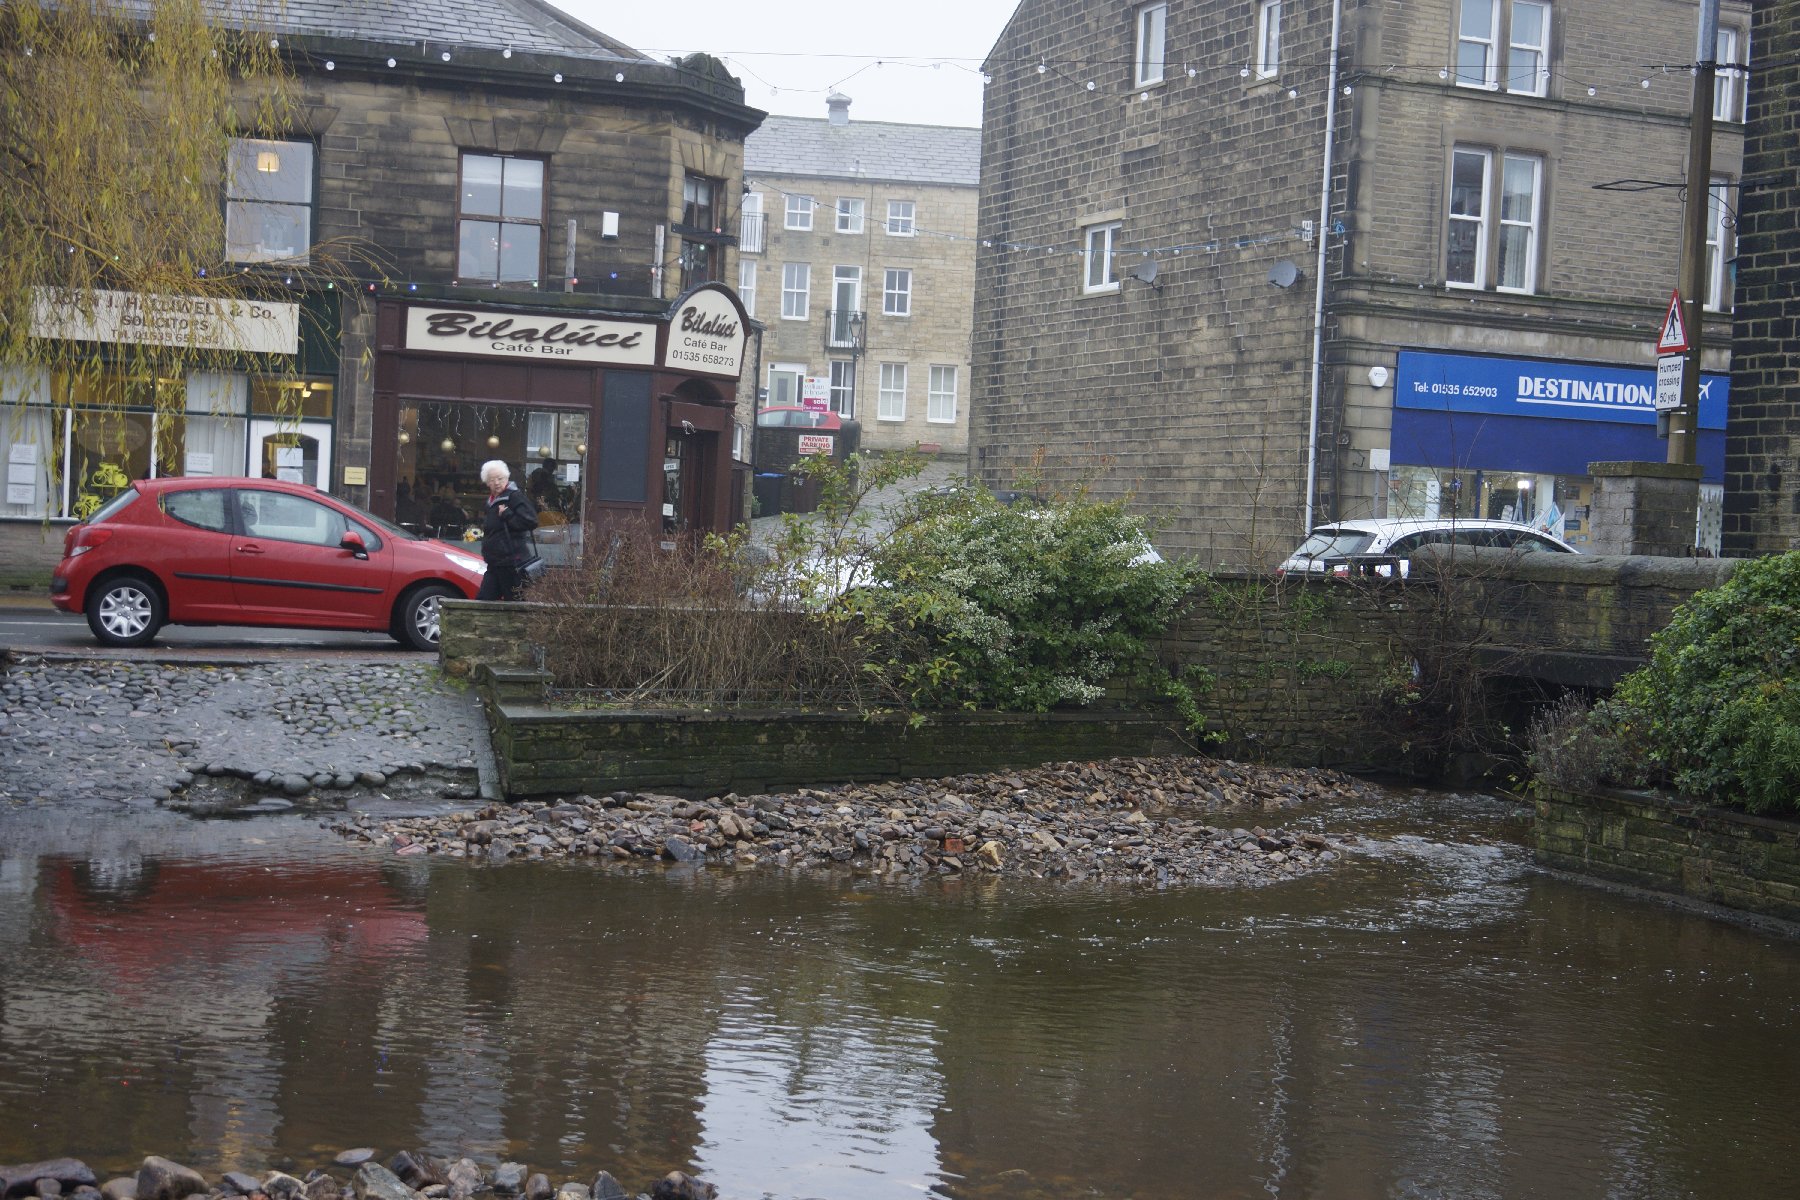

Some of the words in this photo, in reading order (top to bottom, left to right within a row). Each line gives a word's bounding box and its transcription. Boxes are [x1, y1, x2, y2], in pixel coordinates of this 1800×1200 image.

[250, 305, 277, 320] Co.
[426, 312, 643, 349] Bilalúci
[682, 306, 738, 338] Bilalúci
[491, 341, 534, 353] Café
[541, 345, 573, 356] Bar
[684, 337, 707, 349] Café
[711, 341, 728, 352] Bar
[672, 349, 700, 362] 01535
[702, 354, 735, 367] 658273
[1413, 381, 1429, 393] Tel:
[1431, 383, 1460, 395] 01535
[1462, 385, 1498, 398] 652903
